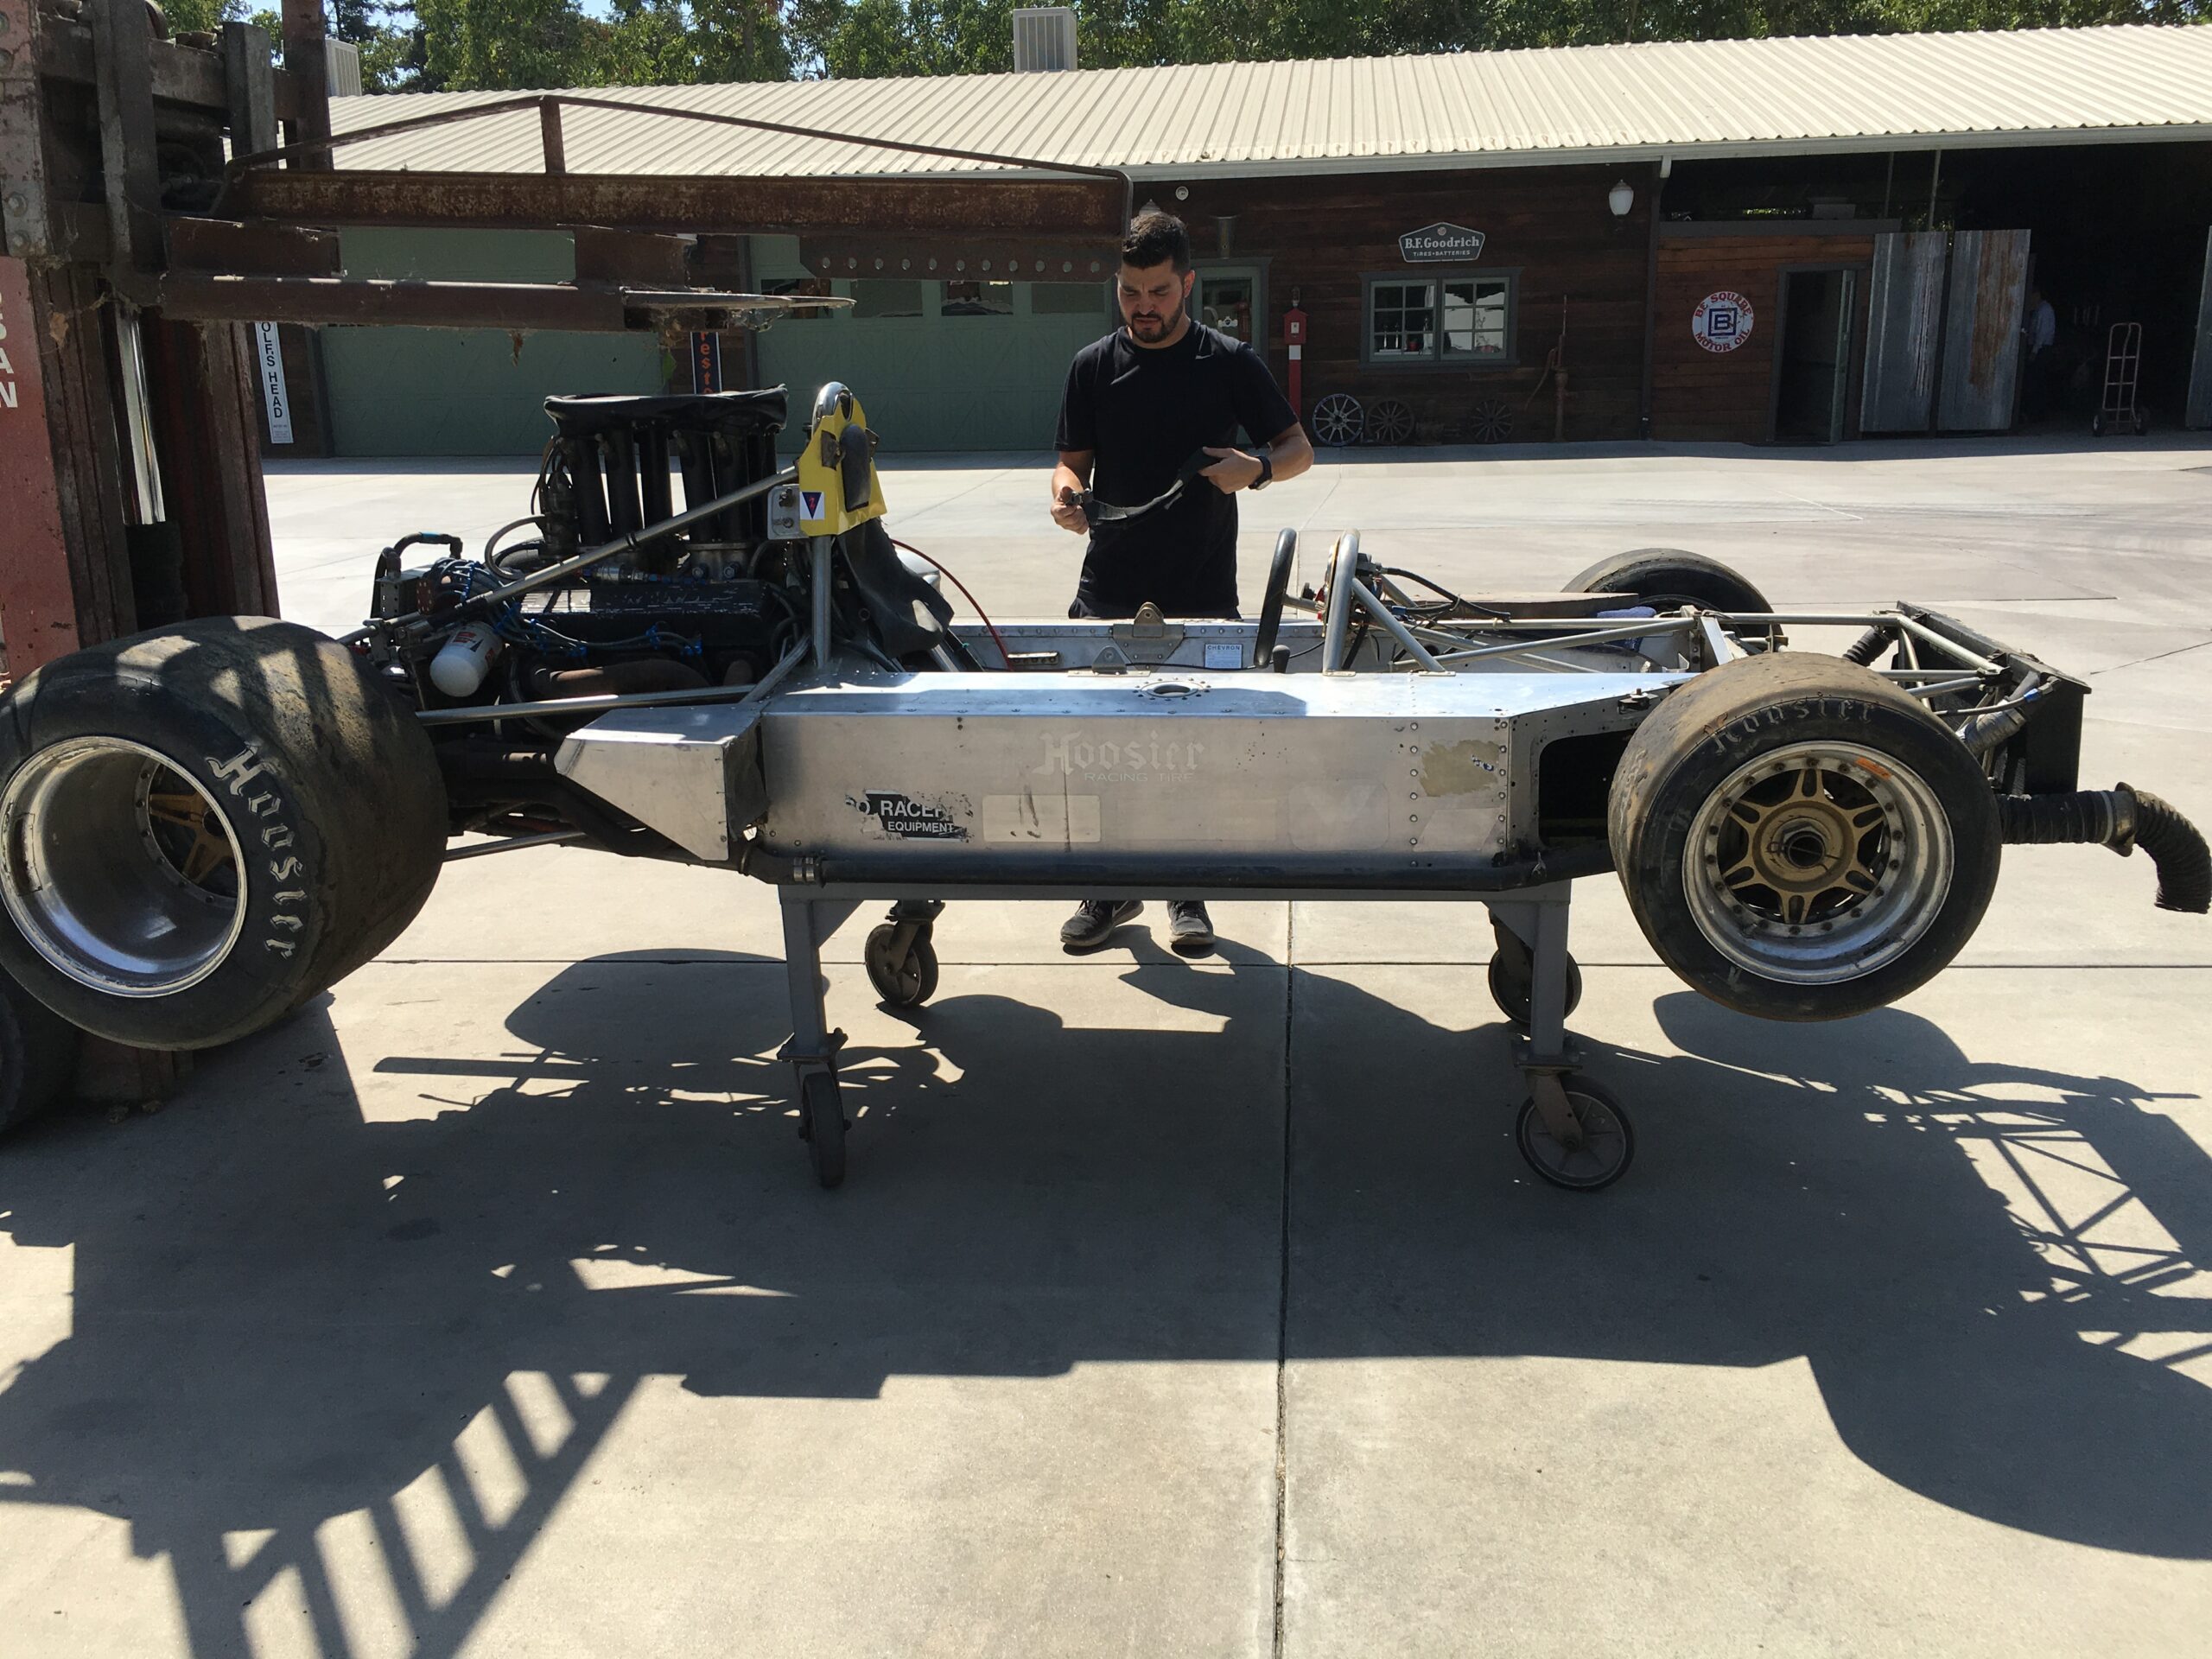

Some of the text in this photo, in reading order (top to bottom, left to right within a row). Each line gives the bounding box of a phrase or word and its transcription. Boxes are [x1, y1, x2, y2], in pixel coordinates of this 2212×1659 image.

[1694, 292, 1751, 318] BE SQUARE
[261, 321, 276, 367] OLF'S
[1695, 328, 1750, 351] MOTOR OIL
[268, 372, 283, 418] HEAD
[1032, 730, 1205, 775] Hoosier
[1084, 772, 1195, 782] RACING TIRE
[887, 821, 955, 832] EQUIPMENT
